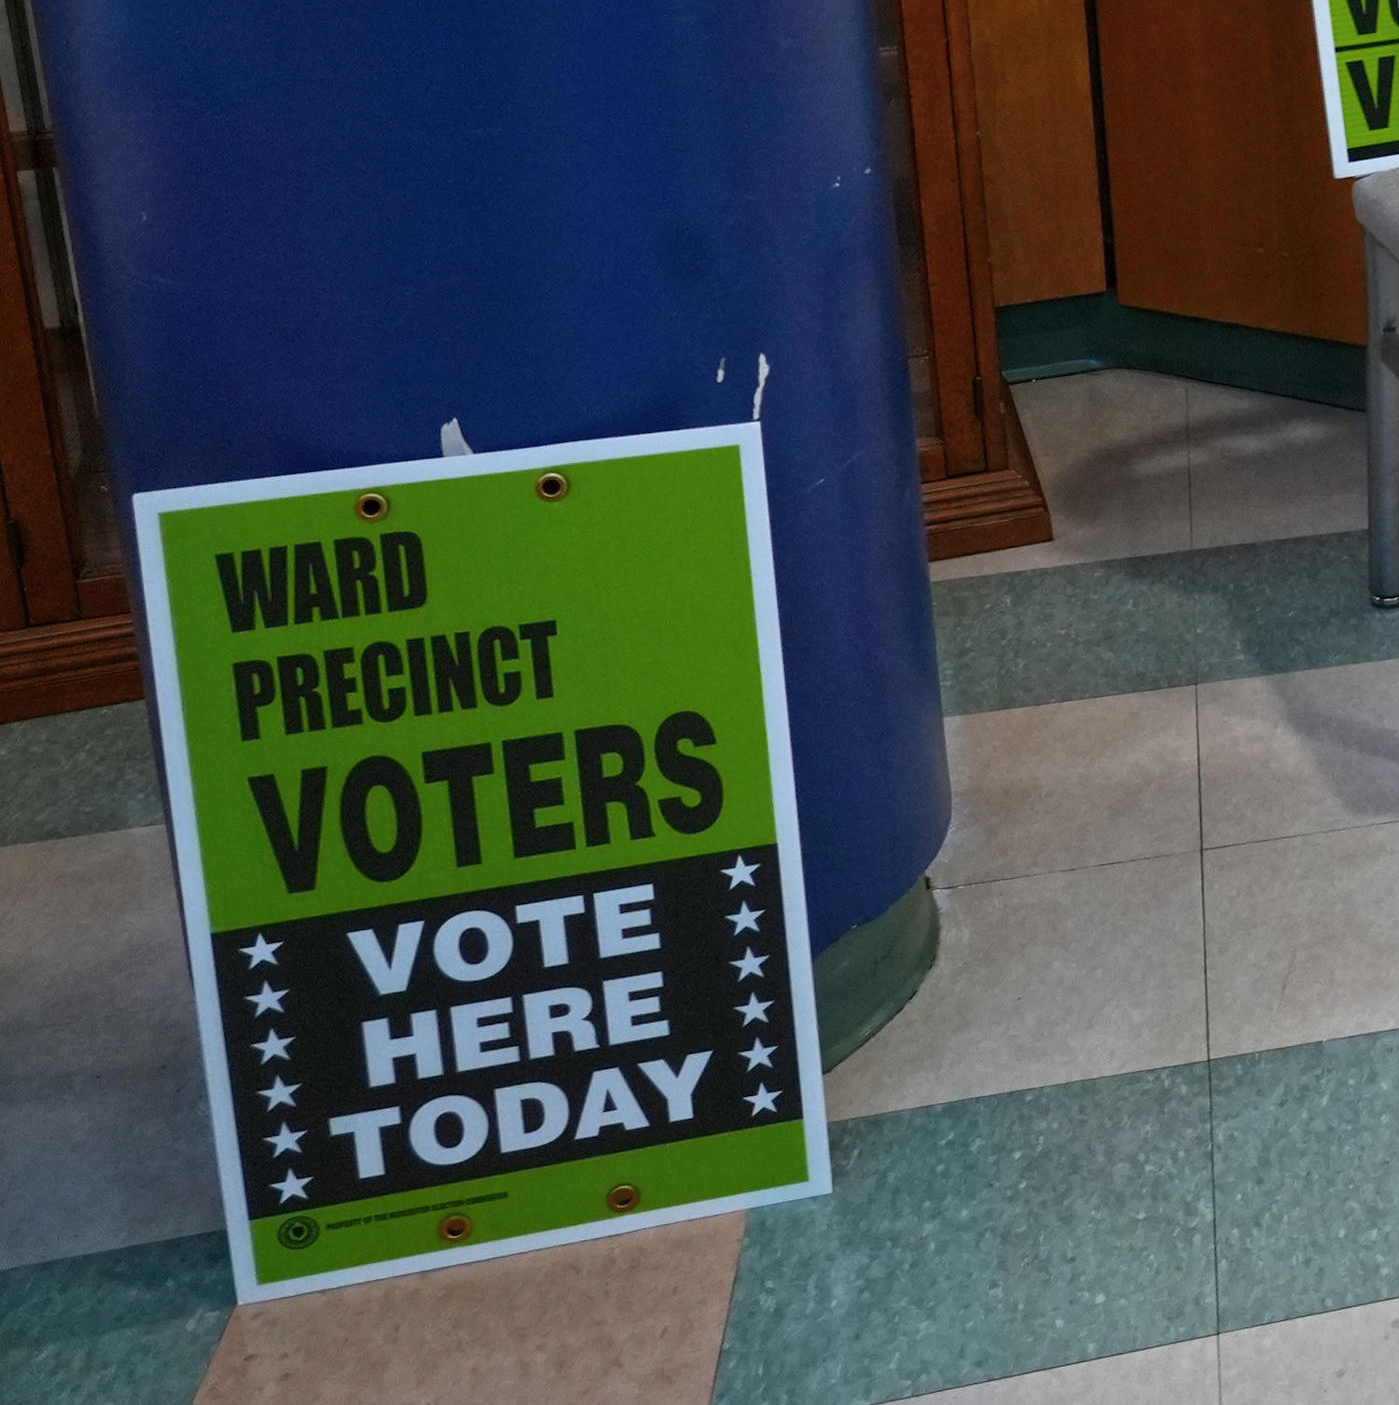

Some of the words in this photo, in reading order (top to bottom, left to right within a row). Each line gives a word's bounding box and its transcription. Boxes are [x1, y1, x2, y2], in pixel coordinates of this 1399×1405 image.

[215, 530, 428, 633] WARD
[234, 620, 559, 741] PRECINCT
[248, 709, 725, 895] VOTERS
[347, 882, 662, 995] VOTE
[361, 971, 671, 1088] HERE
[329, 1050, 715, 1179] TODAY
